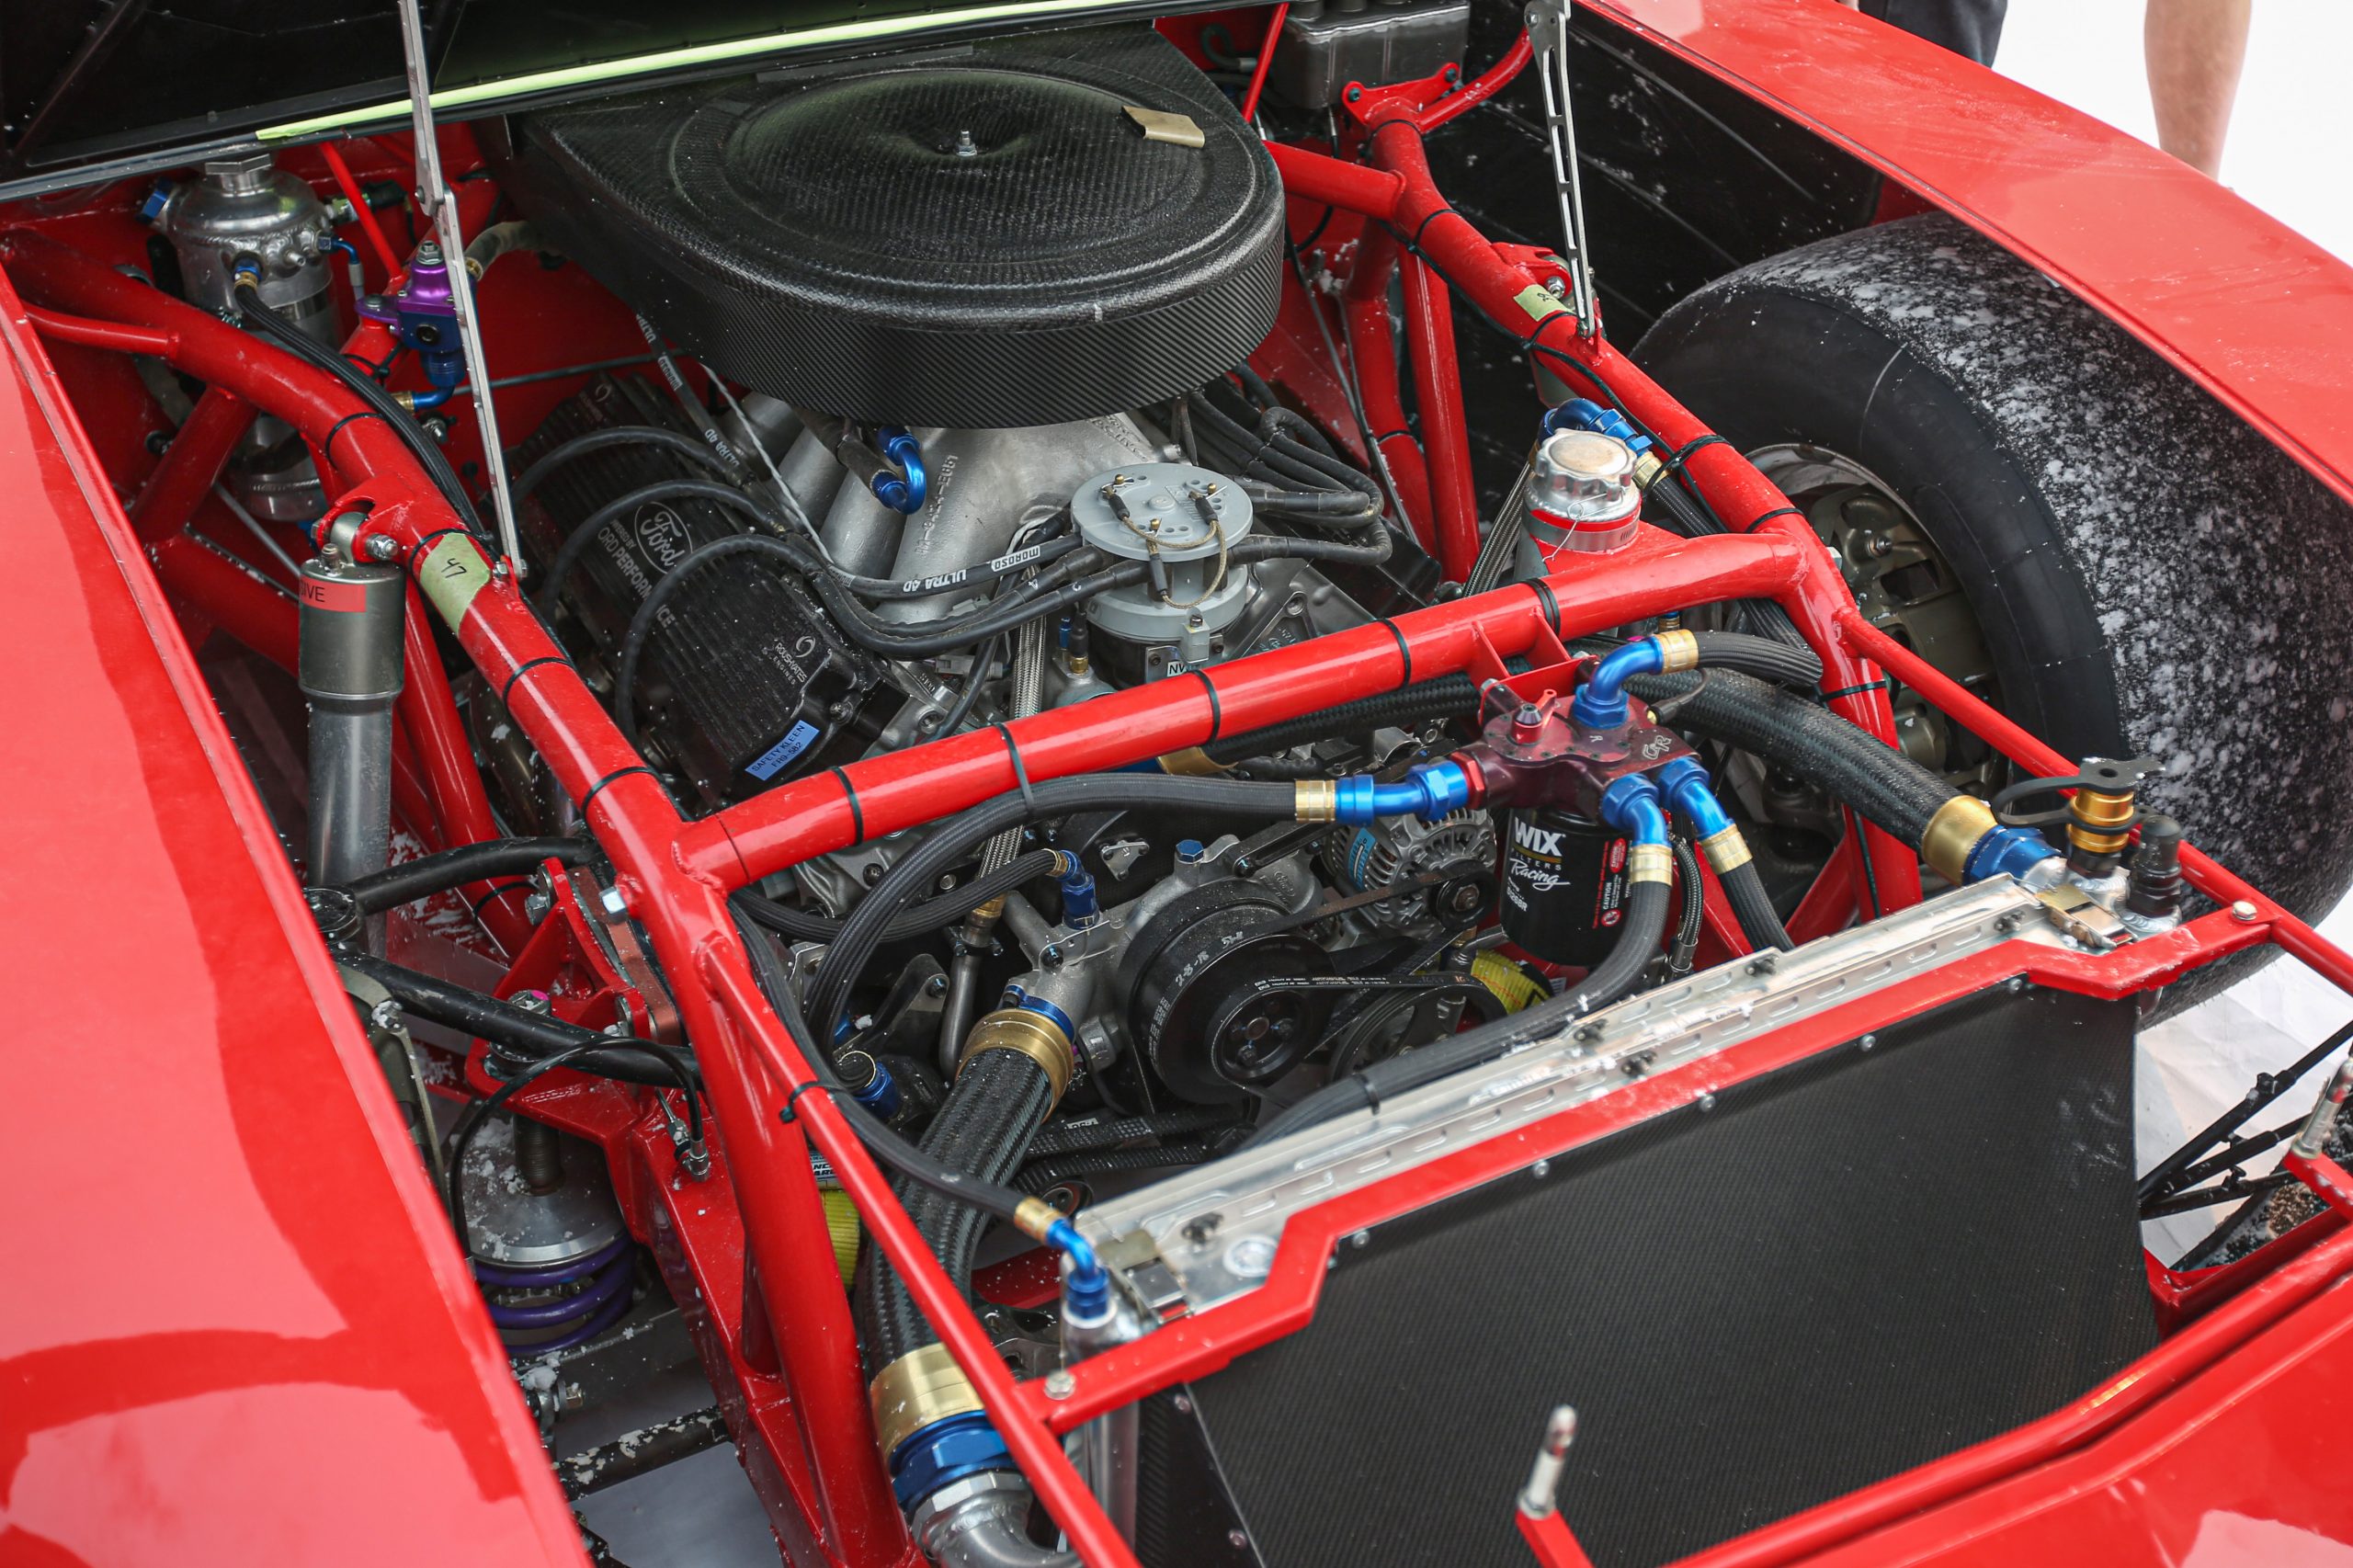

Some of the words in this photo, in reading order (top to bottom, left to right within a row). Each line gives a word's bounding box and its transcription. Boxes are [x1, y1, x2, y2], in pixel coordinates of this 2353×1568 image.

[715, 441, 740, 467] ULTRA
[597, 527, 620, 552] ORD
[640, 511, 685, 567] Ford
[993, 547, 1039, 570] MOROSO
[903, 581, 920, 593] 40
[925, 569, 966, 590] ULTRA
[752, 748, 782, 772] SAFETY
[779, 724, 806, 750] KLEEN
[770, 741, 803, 768] FR9-582
[1514, 816, 1563, 857] WIX
[1509, 857, 1570, 892] Racing
[1602, 881, 1613, 911] CAUTION
